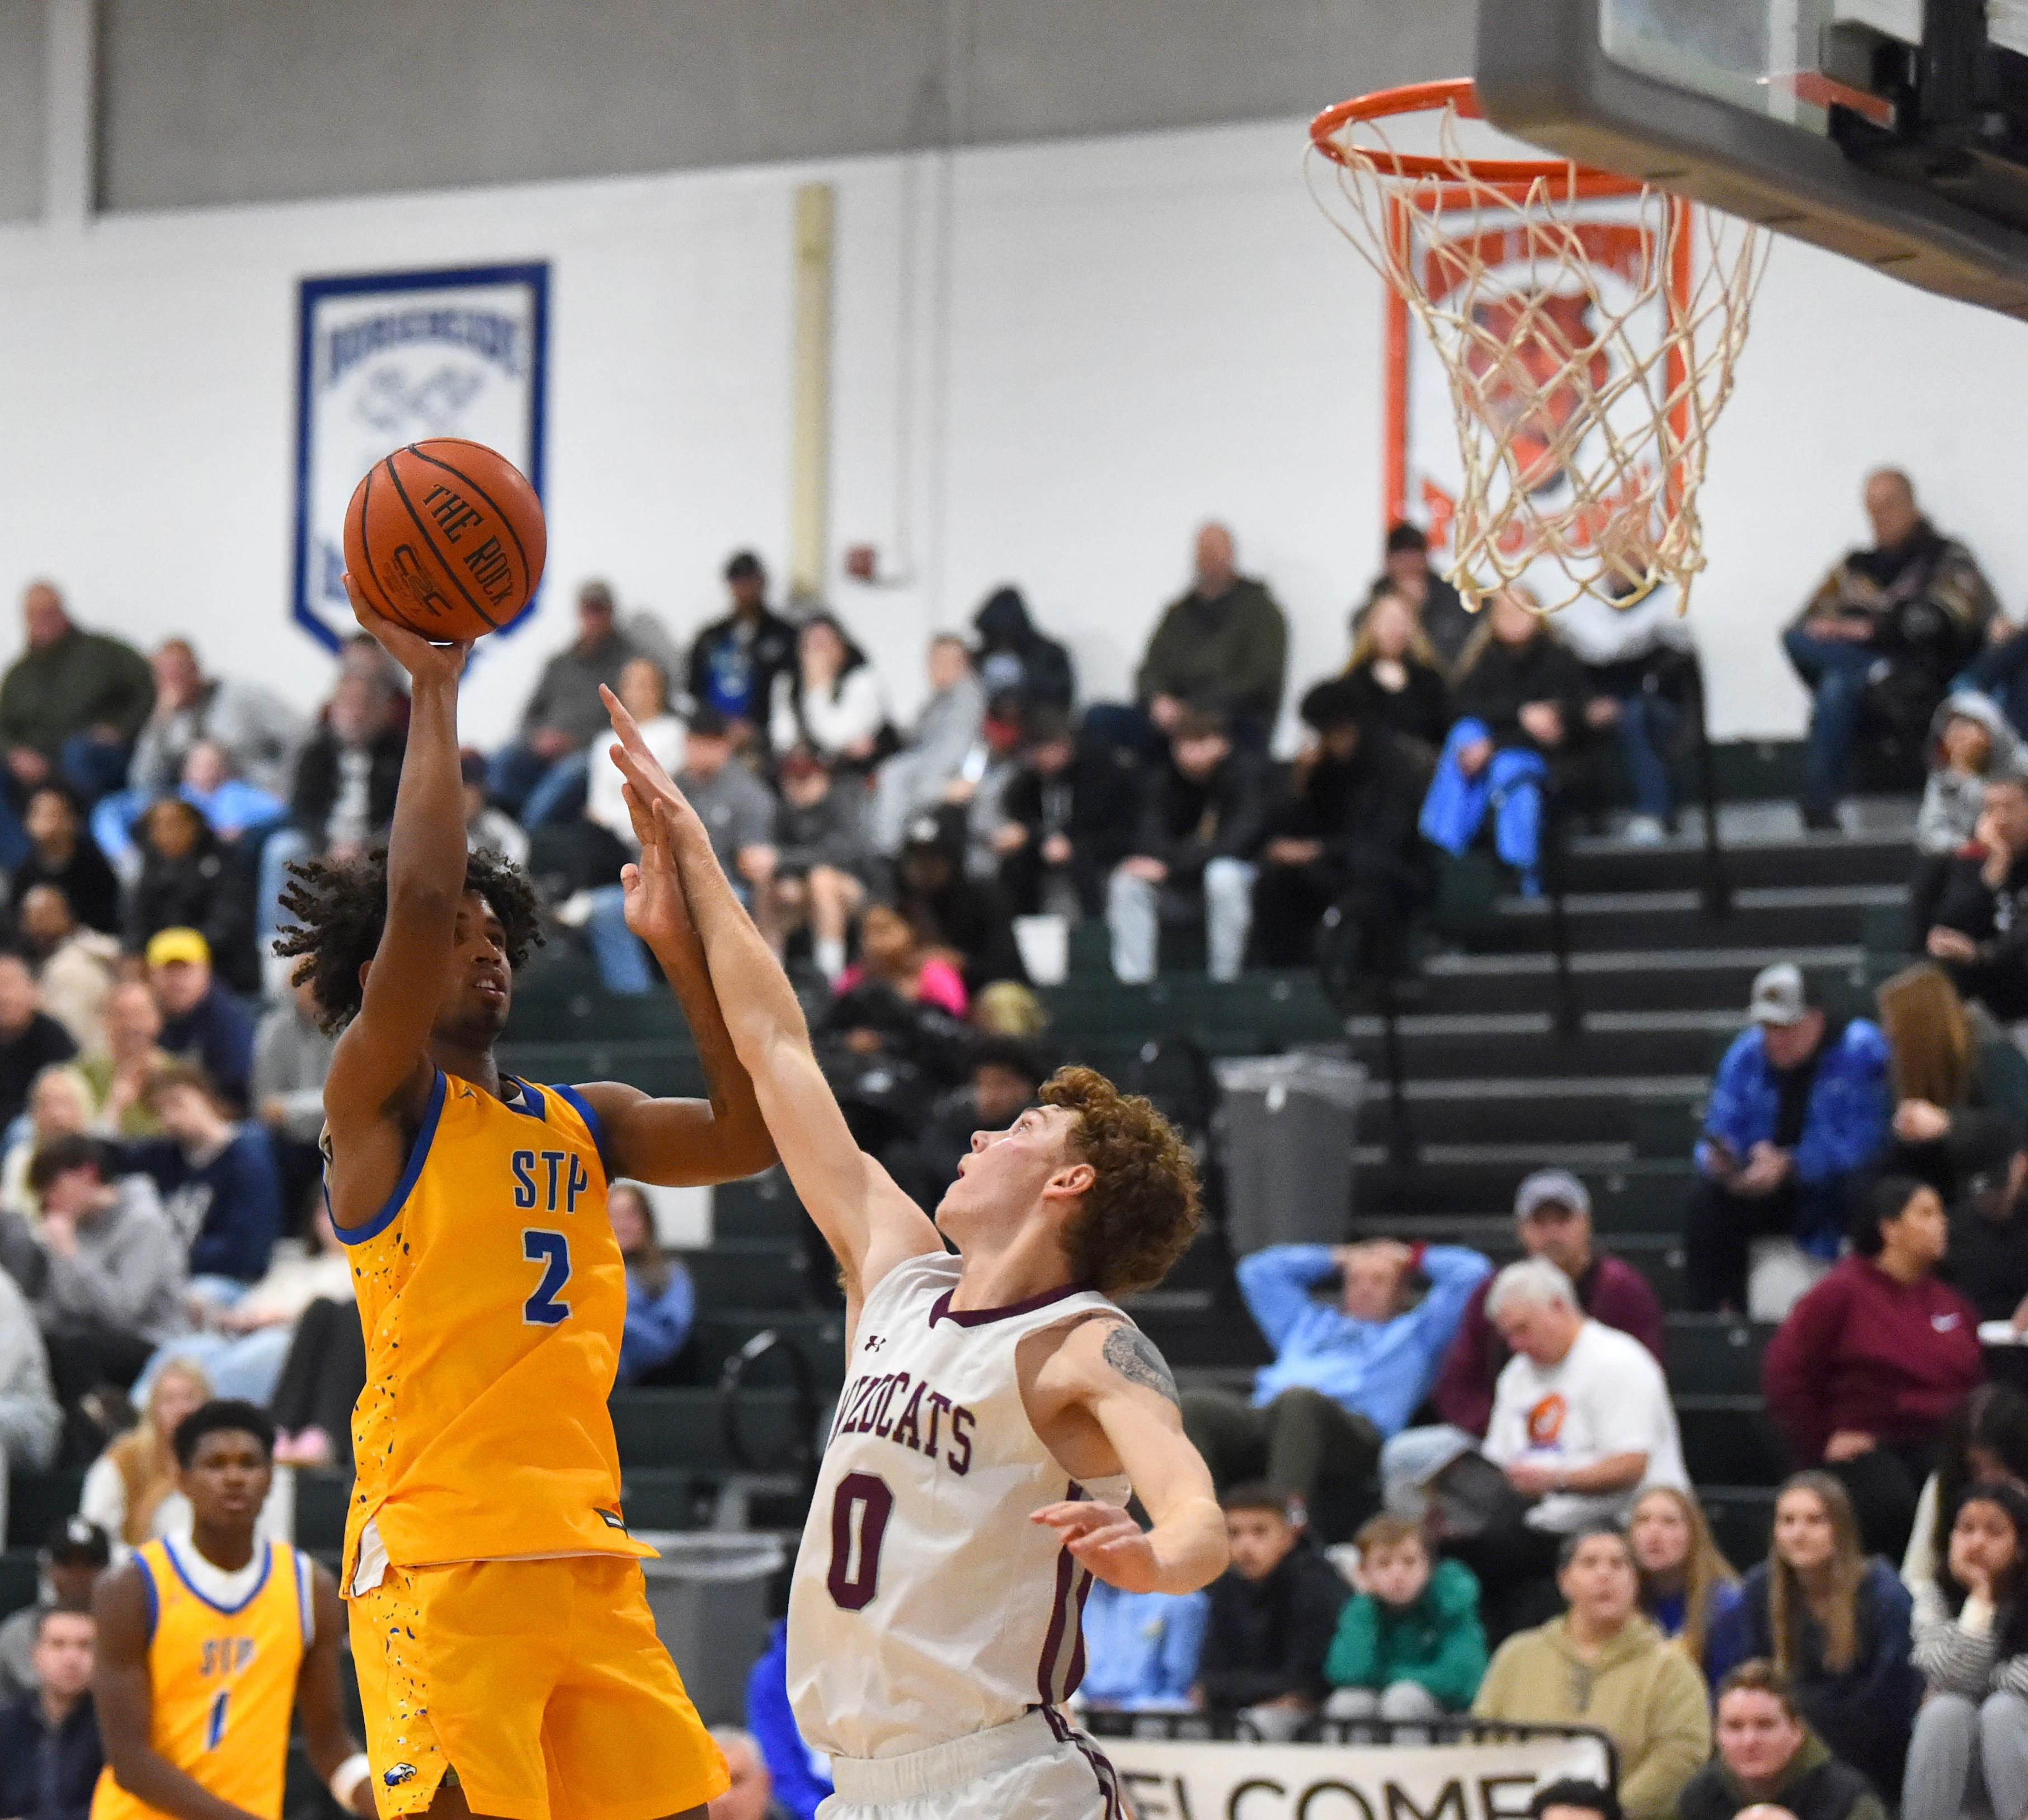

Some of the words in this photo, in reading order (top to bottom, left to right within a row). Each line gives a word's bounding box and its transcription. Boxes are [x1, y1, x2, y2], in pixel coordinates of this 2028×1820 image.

[422, 483, 484, 544] THE
[463, 534, 514, 606] ROCK
[511, 1149, 588, 1214] STP
[521, 1227, 573, 1327] 2
[827, 1469, 896, 1613] 0
[199, 1637, 255, 1676] STP
